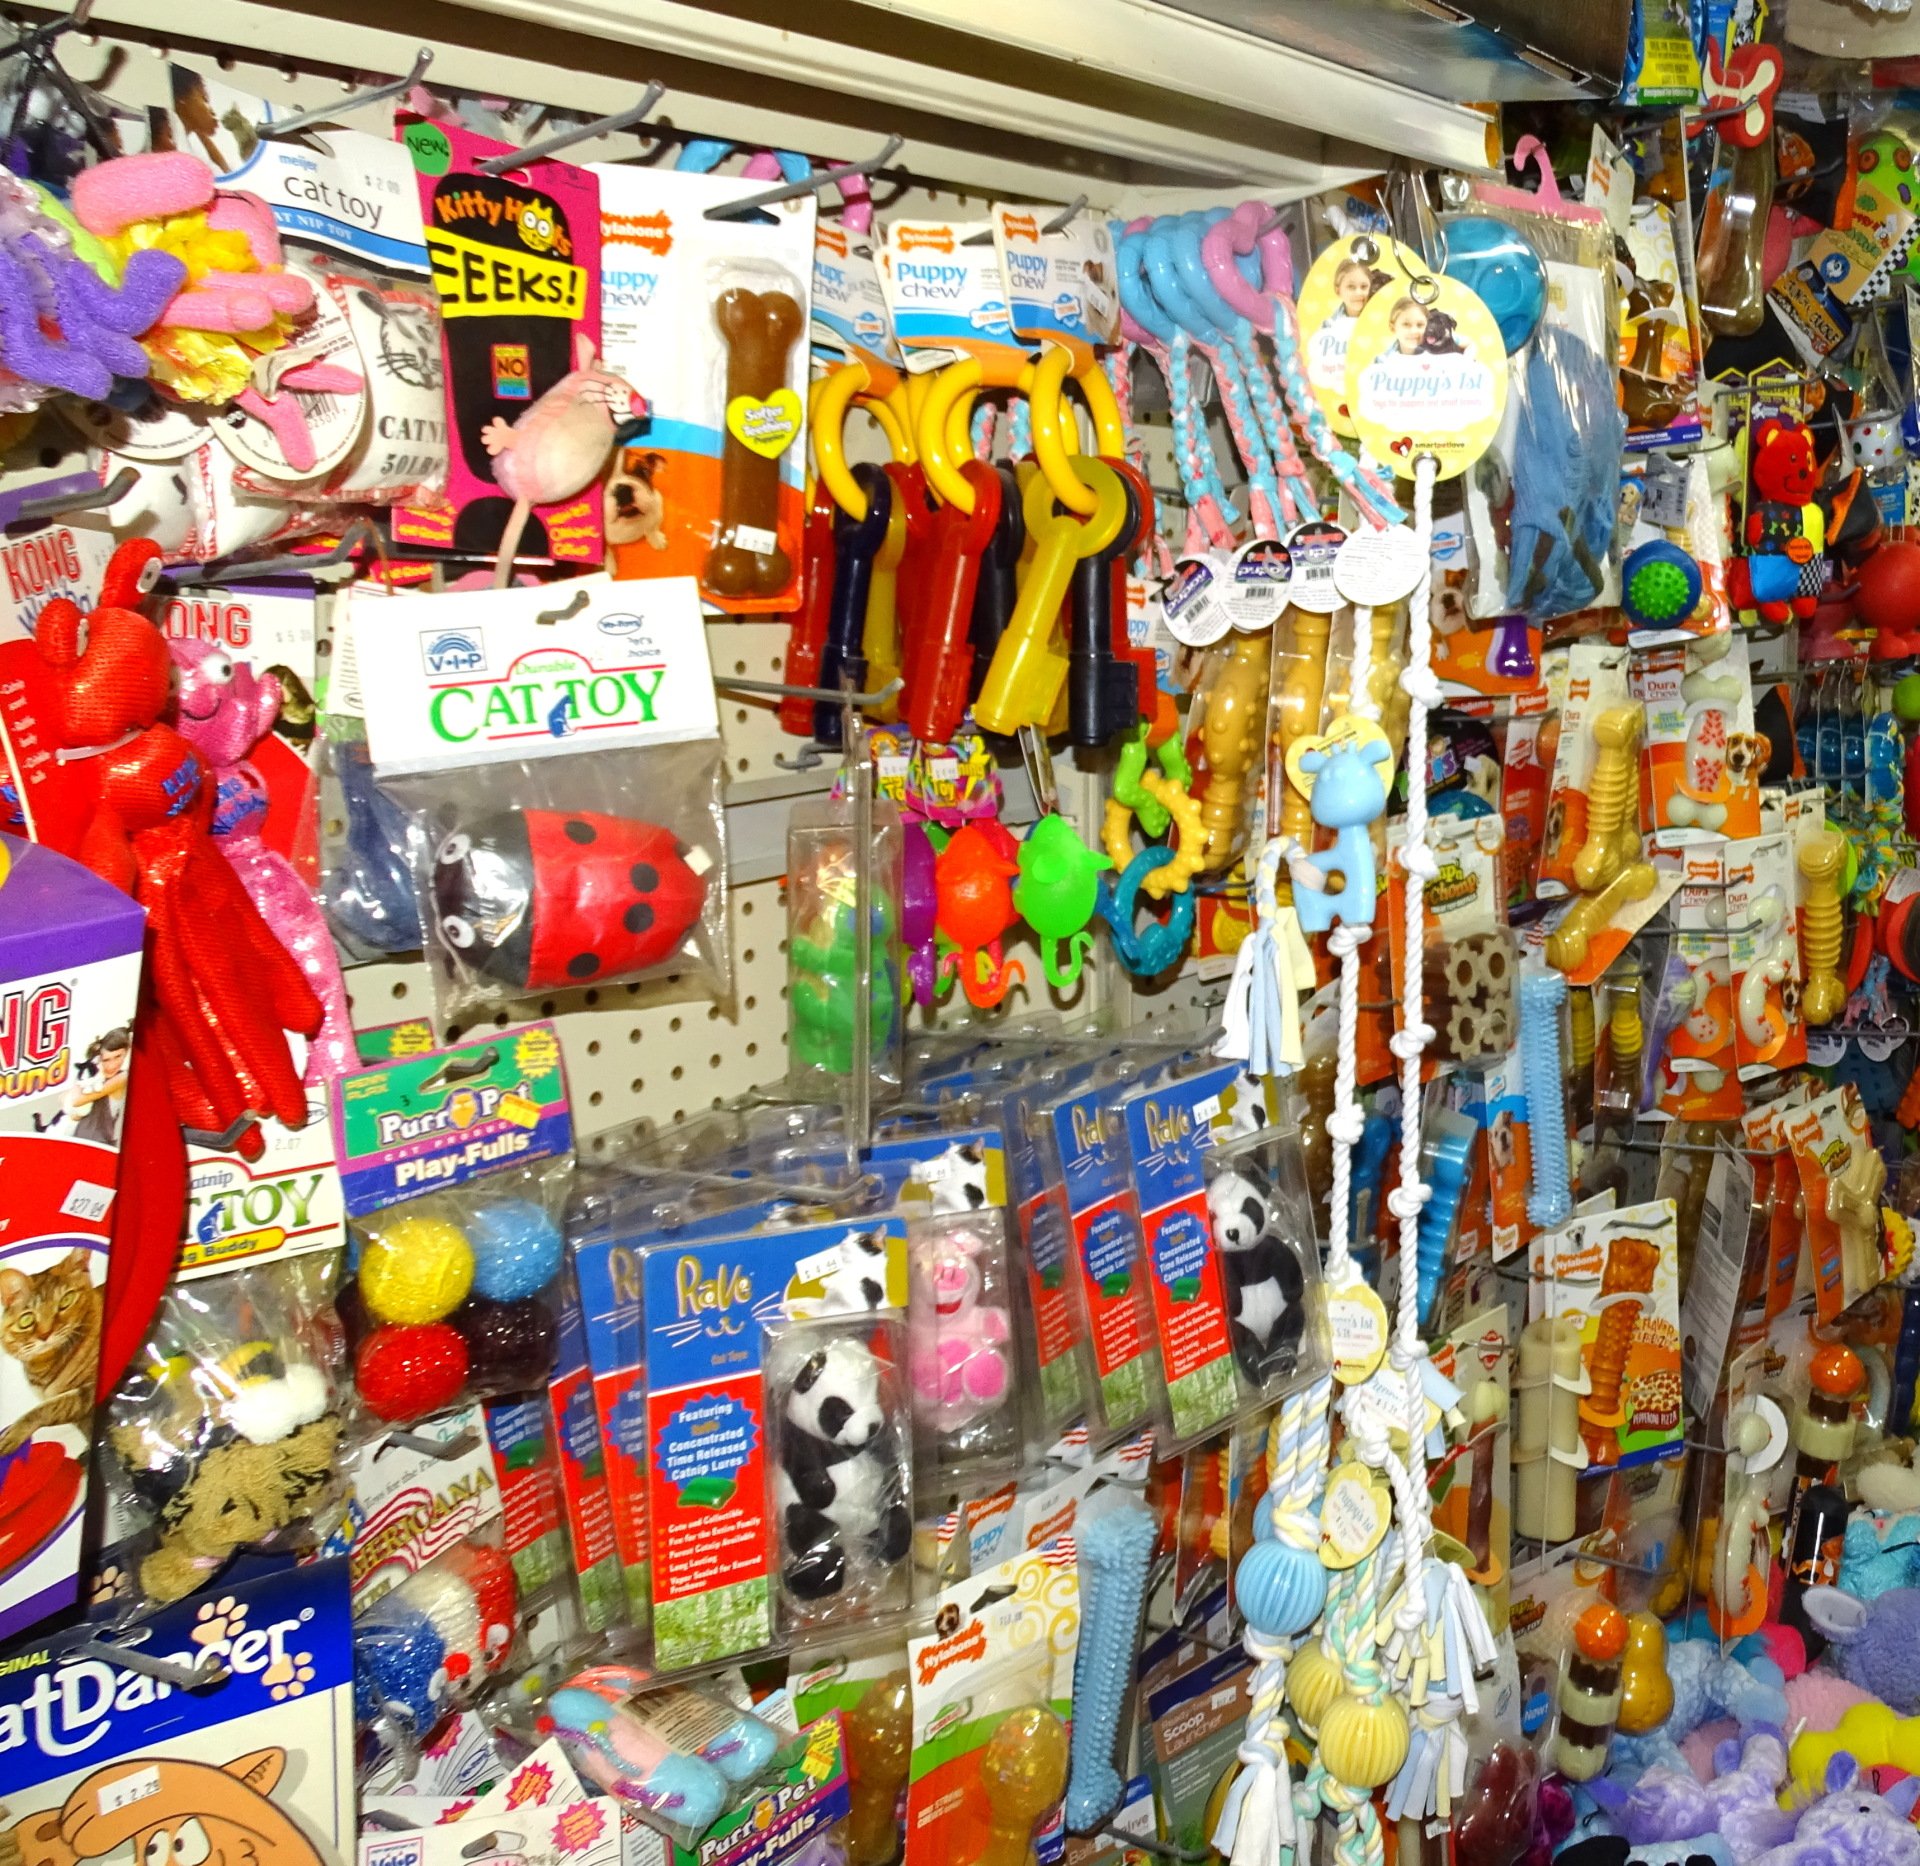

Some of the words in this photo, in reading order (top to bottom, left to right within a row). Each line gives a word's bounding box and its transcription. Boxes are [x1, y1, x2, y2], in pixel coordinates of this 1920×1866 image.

[406, 136, 450, 157] New!
[279, 154, 318, 172] meijer
[284, 176, 332, 208] cat
[337, 189, 382, 229] toy
[435, 190, 502, 227] Kitty
[273, 210, 292, 224] AT
[297, 215, 324, 230] NIP
[328, 222, 352, 240] TOY
[602, 222, 663, 240] ylabone
[814, 261, 847, 284] upp
[897, 262, 968, 285] Puppy
[1006, 250, 1048, 276] Puppy
[602, 270, 658, 289] uppy
[901, 281, 962, 299] chew
[1011, 270, 1047, 290] chew
[602, 289, 649, 307] hew
[498, 358, 526, 377] NO
[1371, 370, 1453, 397] Puppy's
[379, 415, 447, 445] CATN
[1415, 441, 1466, 449] smartpetlove
[3, 528, 81, 603] KONG
[162, 600, 252, 648] ONG
[516, 658, 577, 676] Durable
[1647, 680, 1677, 691] Dura
[429, 683, 543, 743] CAT
[554, 670, 666, 722] TOY
[1728, 894, 1748, 905] Dura
[0, 981, 71, 1071] NG
[380, 1108, 450, 1145] Purr
[480, 1081, 530, 1117] Pt
[384, 1146, 420, 1162] CAT
[435, 1121, 508, 1147] PRODUC
[395, 1132, 530, 1187] Play-Fulls
[191, 1170, 234, 1190] atnip
[210, 1174, 324, 1233] TOY
[1091, 1214, 1121, 1236] Featuring
[1161, 1217, 1193, 1237] Featuring
[205, 1238, 259, 1257] Buddy
[1159, 1235, 1202, 1262] Concentrated
[1159, 1259, 1175, 1274] Time
[1175, 1246, 1204, 1265] Released
[1090, 1257, 1105, 1272] Time
[1163, 1268, 1184, 1284] Catnip
[1185, 1259, 1204, 1274] Lures
[1557, 1254, 1600, 1272] Nylabone
[679, 1402, 734, 1424] Featuring
[1660, 1409, 1678, 1424] PIZZA
[668, 1425, 745, 1455] Concentrated
[666, 1454, 695, 1469] Time
[696, 1439, 748, 1461] Released
[671, 1463, 709, 1481] Catnip
[711, 1455, 744, 1472] Lures
[668, 1523, 688, 1534] Cute
[688, 1517, 703, 1529] and
[703, 1508, 744, 1526] Collectible
[668, 1537, 684, 1547] Fun
[684, 1533, 697, 1543] for
[697, 1530, 711, 1540] the
[711, 1525, 737, 1537] Entire
[736, 1517, 762, 1530] Family
[694, 1541, 721, 1554] Catnip
[721, 1531, 756, 1548] Available
[669, 1562, 689, 1573] Long
[688, 1554, 719, 1568] Lasting
[693, 1566, 719, 1580] Sealed
[719, 1563, 732, 1574] for
[669, 1579, 708, 1595] Freshness
[0, 1649, 51, 1677] GINAL
[924, 1635, 980, 1669] Nylabone
[1163, 1711, 1205, 1743] Scoop
[1164, 1713, 1223, 1756] Launcher
[701, 1819, 754, 1866] Purr
[777, 1775, 818, 1812] Pet
[741, 1796, 817, 1854] PRODUCTS
